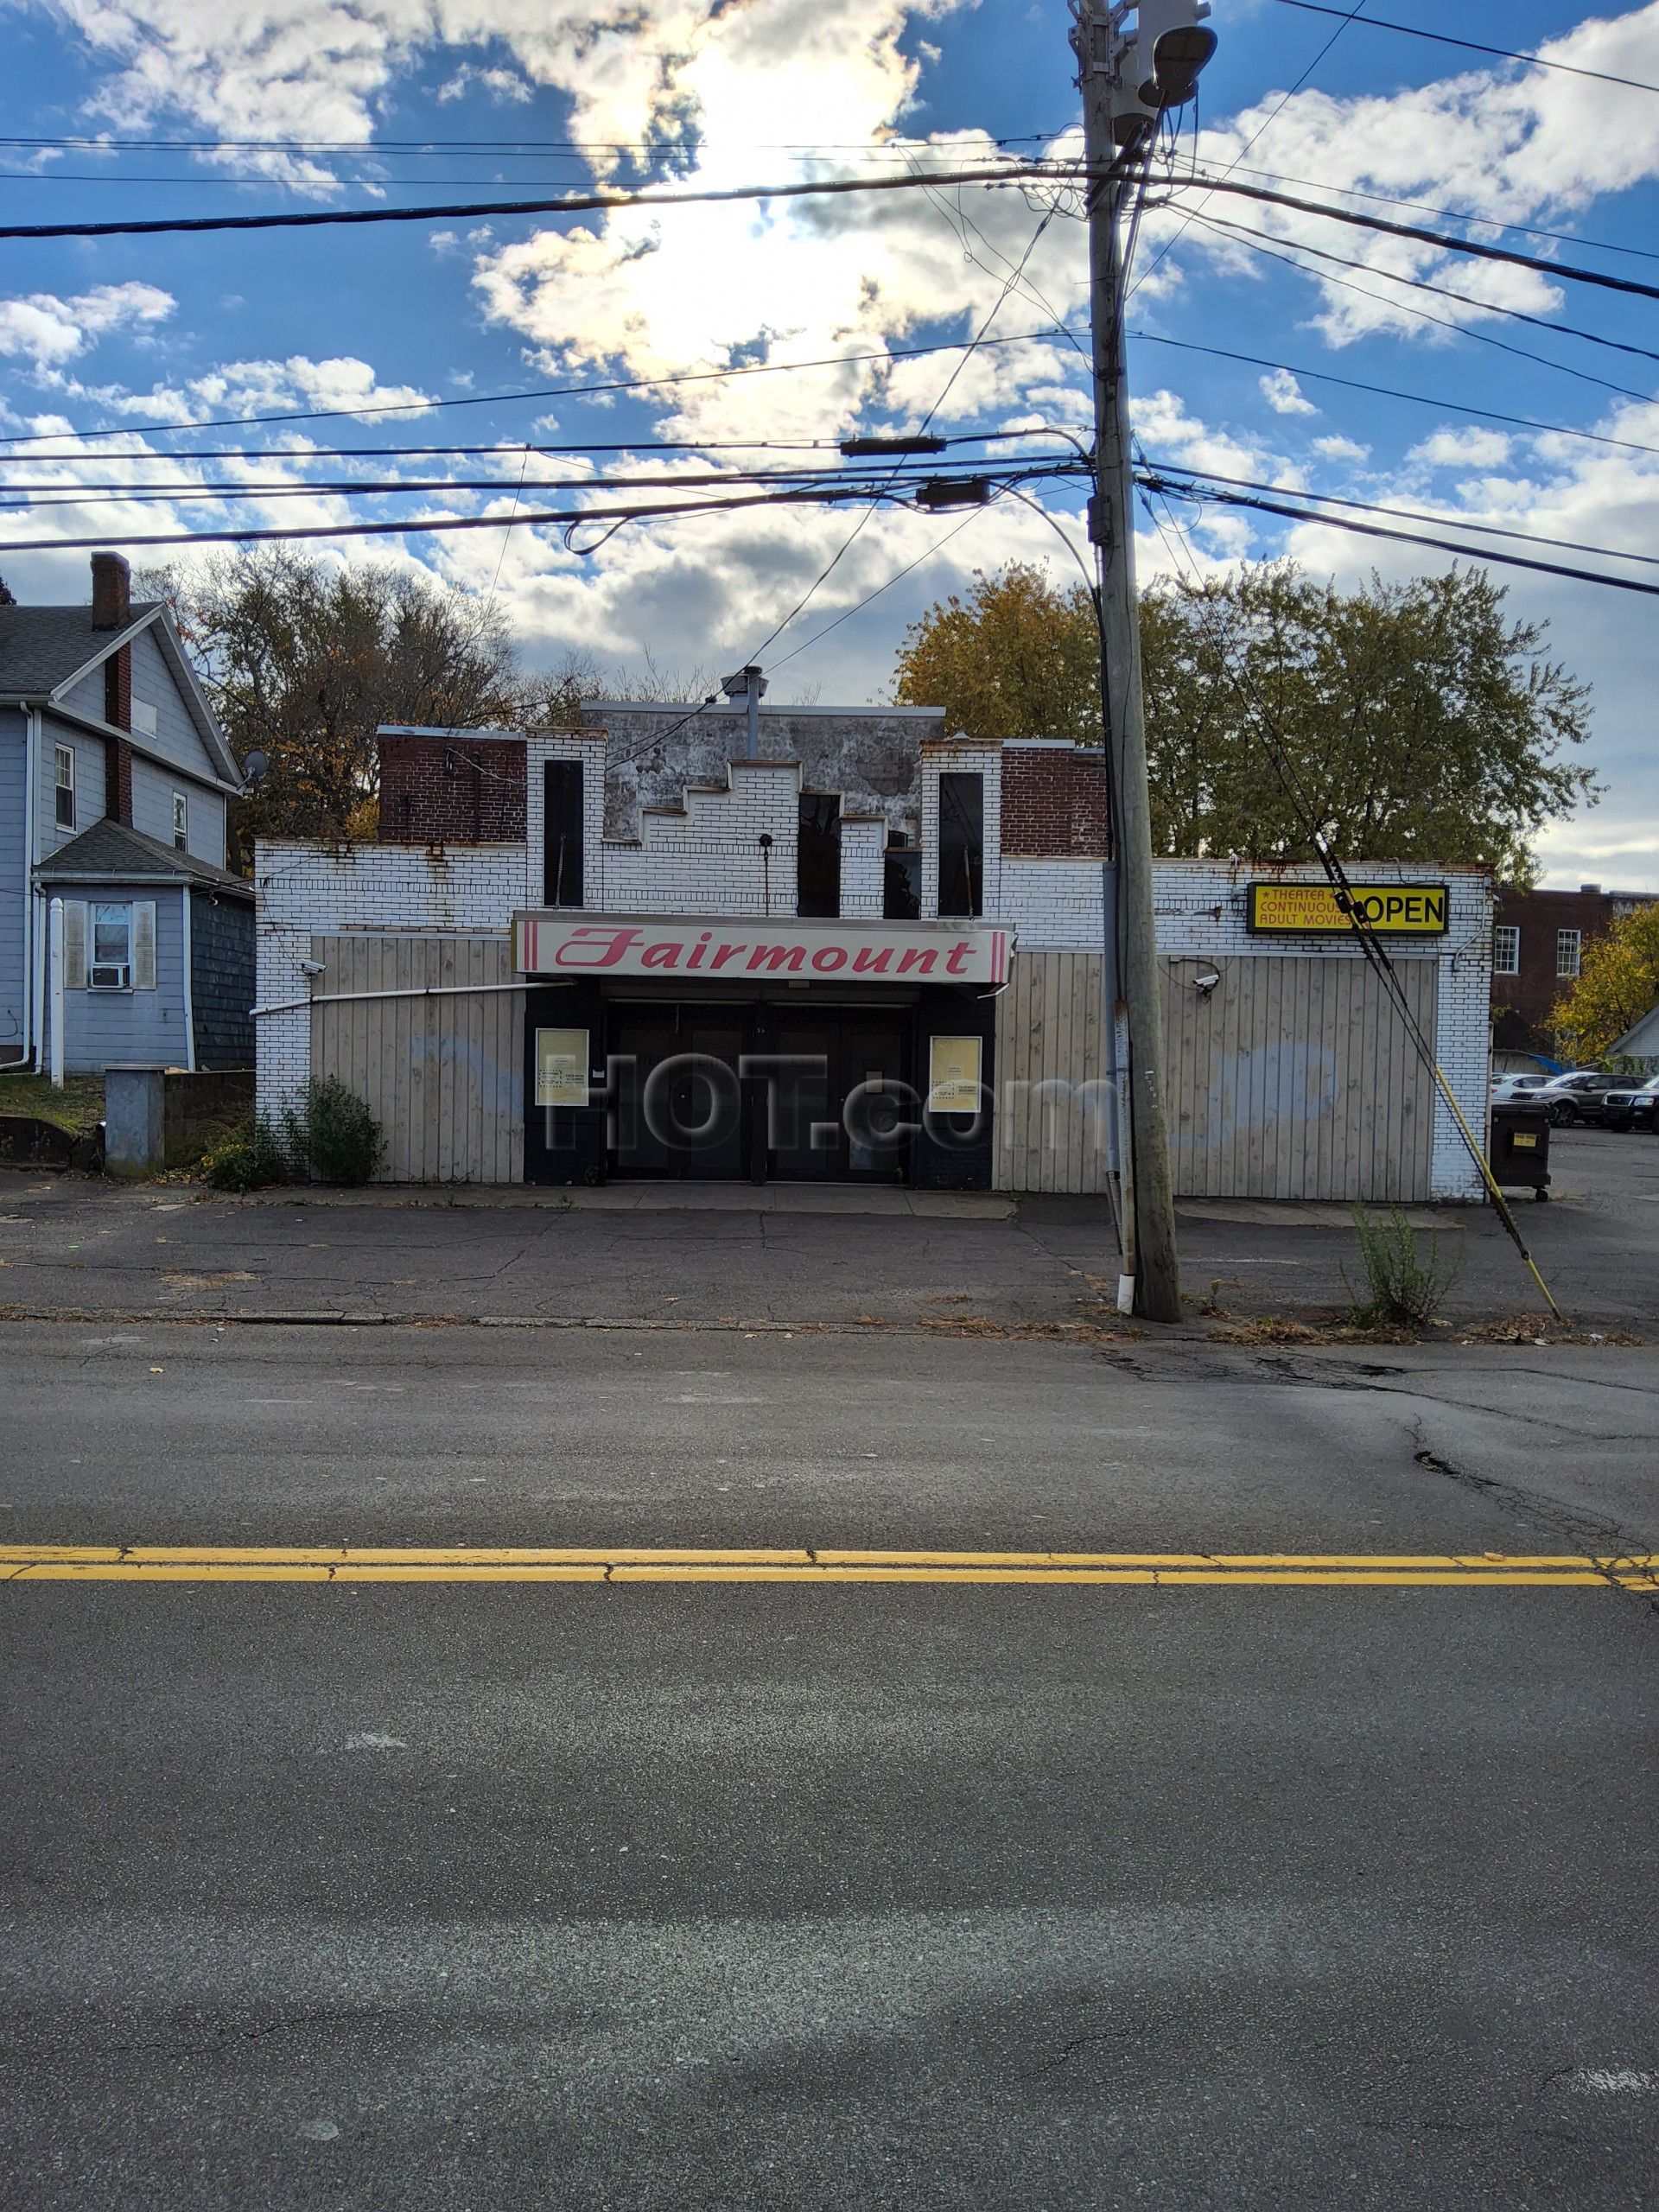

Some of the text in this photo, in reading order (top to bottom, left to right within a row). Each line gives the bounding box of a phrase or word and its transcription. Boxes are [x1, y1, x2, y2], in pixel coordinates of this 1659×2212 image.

[1273, 889, 1325, 900] THEATER
[1260, 913, 1351, 925] ADULT MOVIES
[1363, 895, 1443, 923] OPEN
[555, 927, 977, 975] Fairmount
